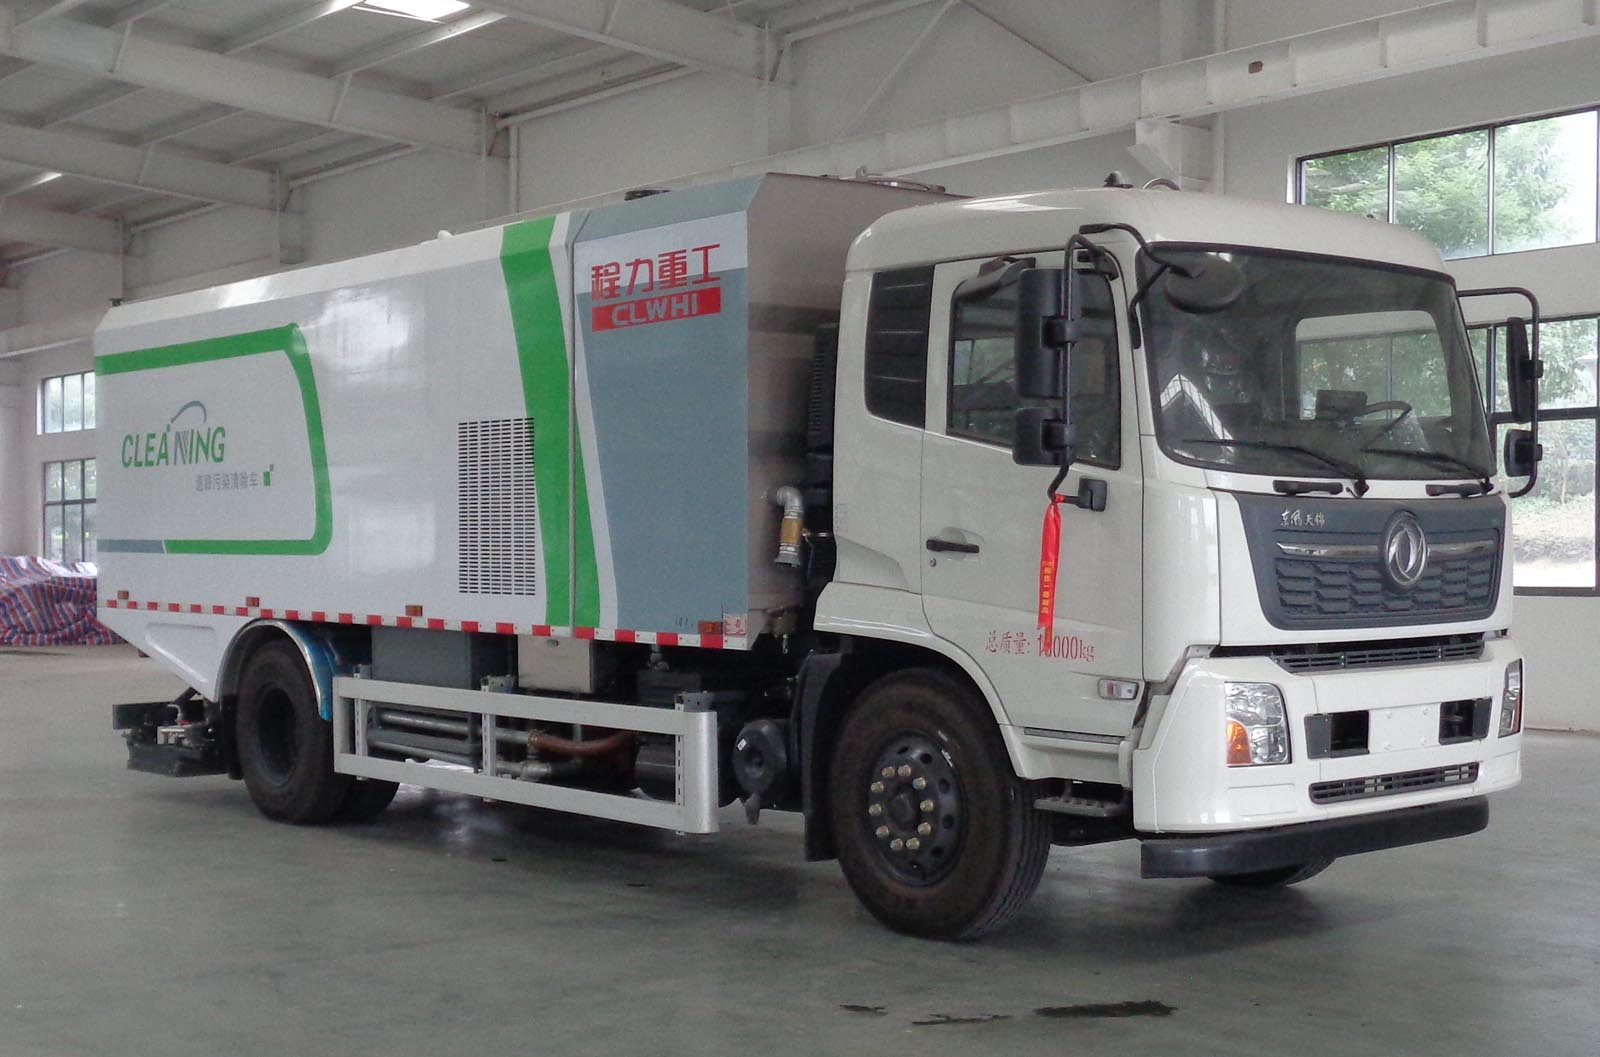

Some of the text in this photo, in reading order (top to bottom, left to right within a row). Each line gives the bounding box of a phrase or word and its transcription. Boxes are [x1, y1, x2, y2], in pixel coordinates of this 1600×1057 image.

[592, 244, 720, 301] 程力重工
[611, 293, 699, 326] CLWHI
[121, 426, 226, 468] CLEANING
[1036, 633, 1095, 661] 1000kg
